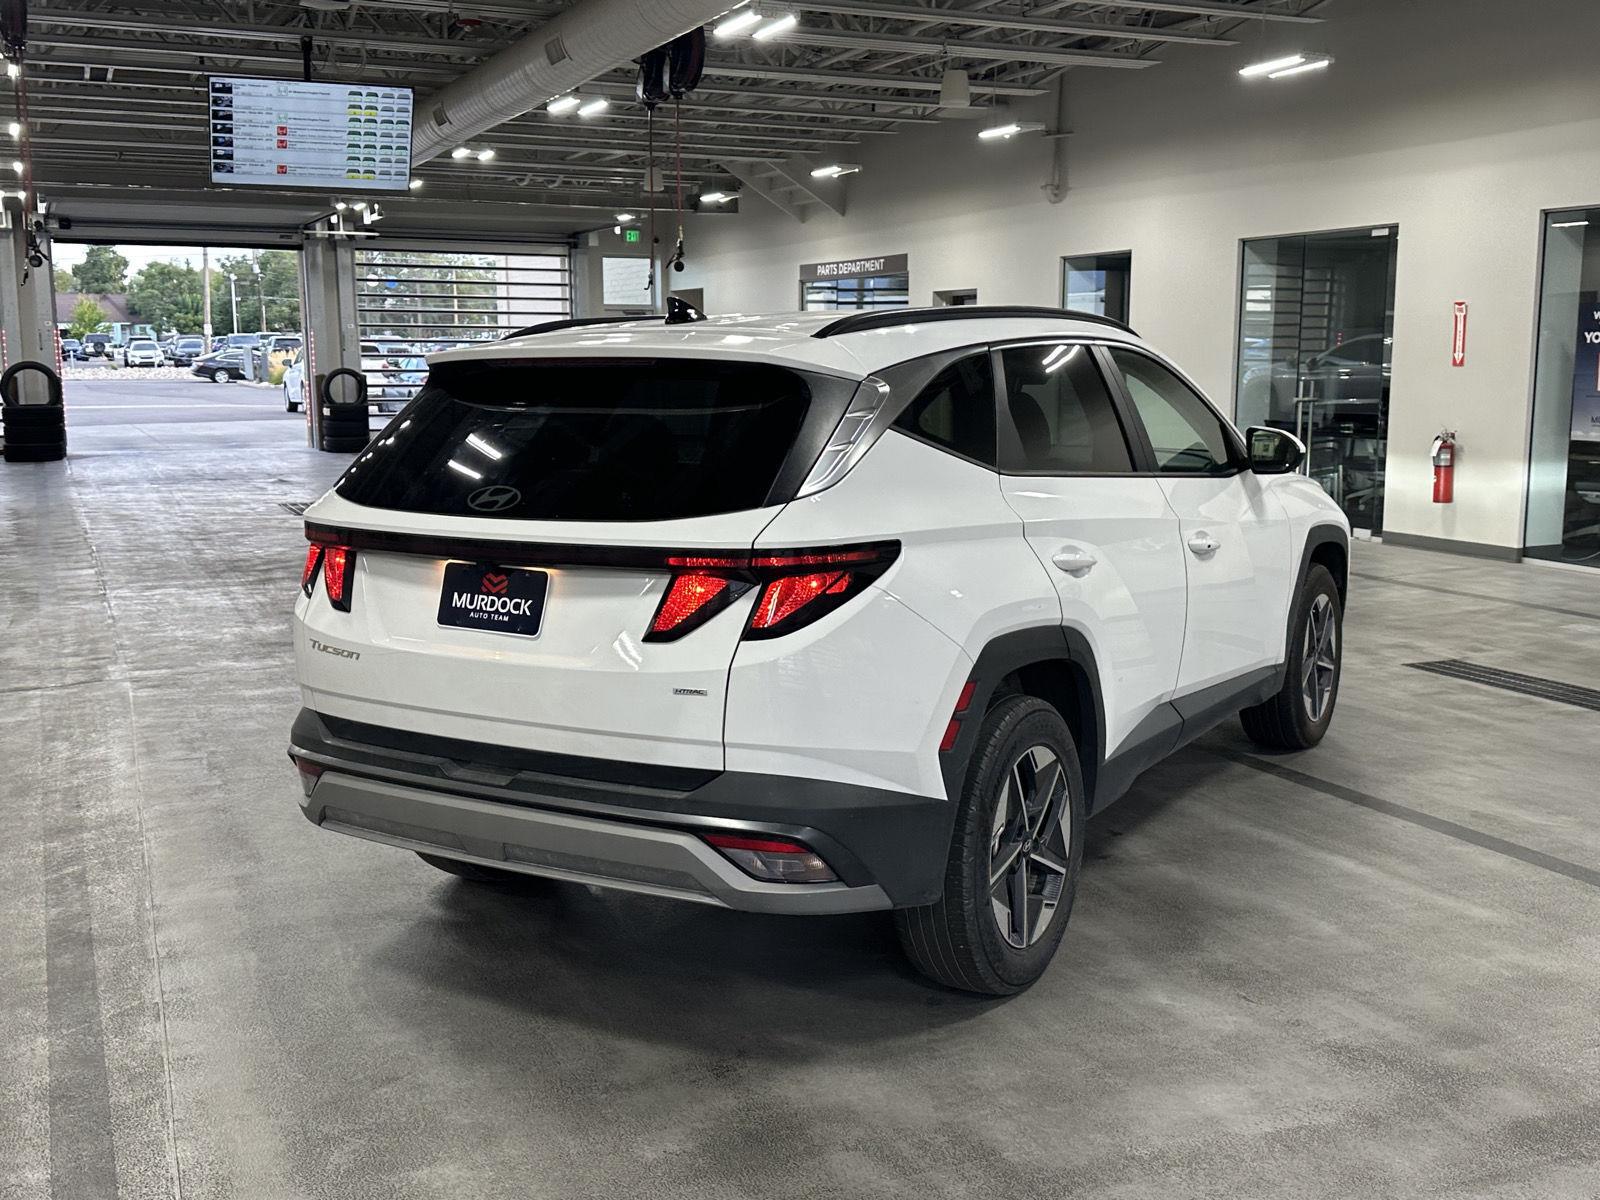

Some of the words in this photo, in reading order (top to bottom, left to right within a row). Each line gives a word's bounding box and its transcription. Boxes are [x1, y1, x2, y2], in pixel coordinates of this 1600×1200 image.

[816, 264, 838, 276] PARTS
[838, 259, 885, 275] DEPARTMENT
[452, 592, 533, 616] MURDOCK
[491, 614, 509, 622] TEAM
